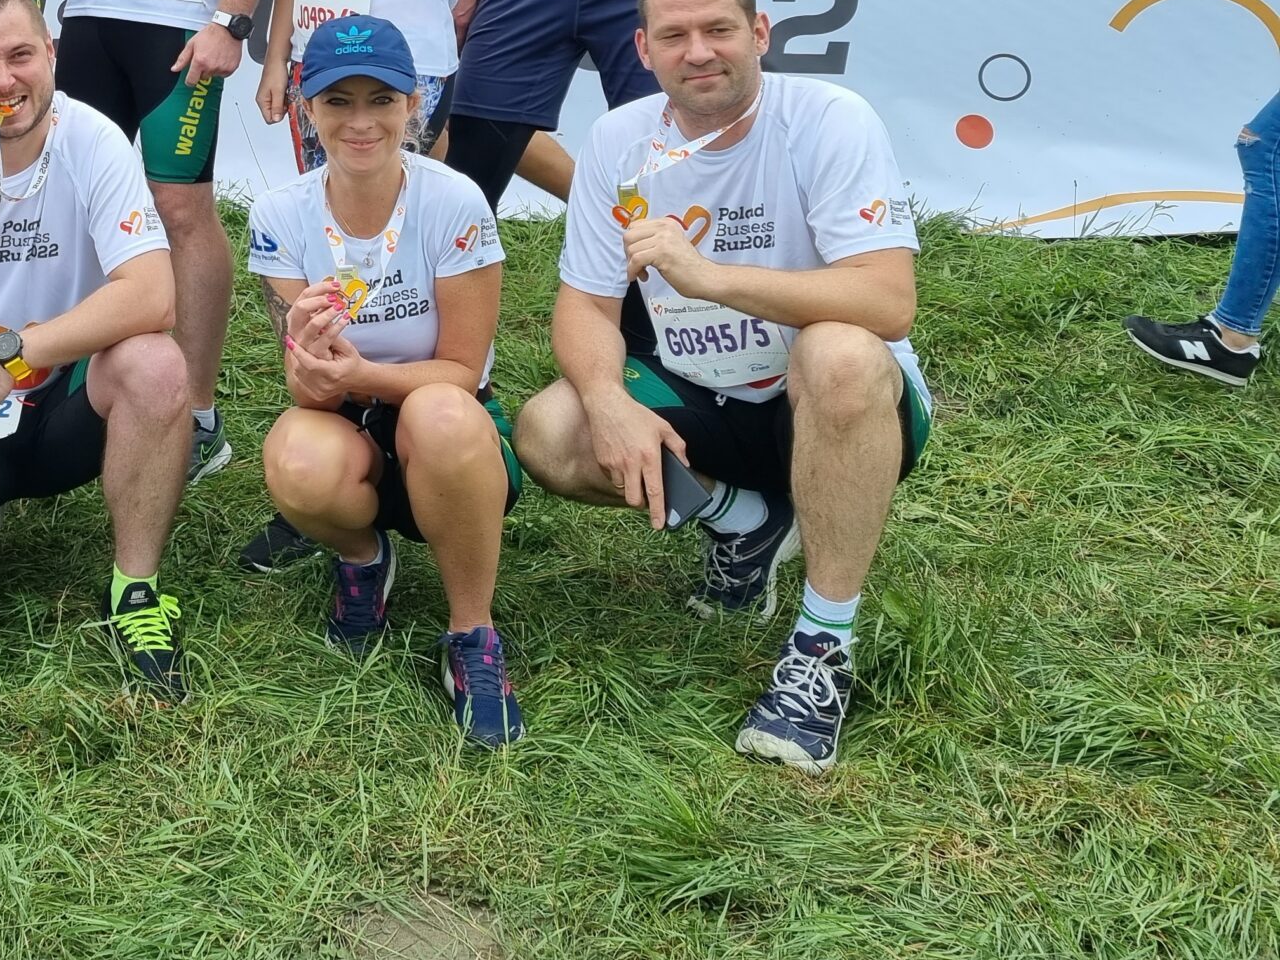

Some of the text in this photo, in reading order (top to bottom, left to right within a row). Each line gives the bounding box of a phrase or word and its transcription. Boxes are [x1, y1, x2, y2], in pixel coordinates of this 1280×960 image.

[297, 4, 361, 30] J0493/
[335, 43, 374, 55] adidas
[174, 76, 212, 155] walrave
[33, 172, 44, 190] Run
[717, 203, 764, 221] Polad
[251, 228, 279, 253] LS
[480, 238, 498, 248] Run
[365, 269, 404, 293] oland
[384, 299, 430, 322] 2022
[664, 306, 687, 314] Poland
[687, 303, 719, 313] Business
[664, 318, 771, 357] G0345/5
